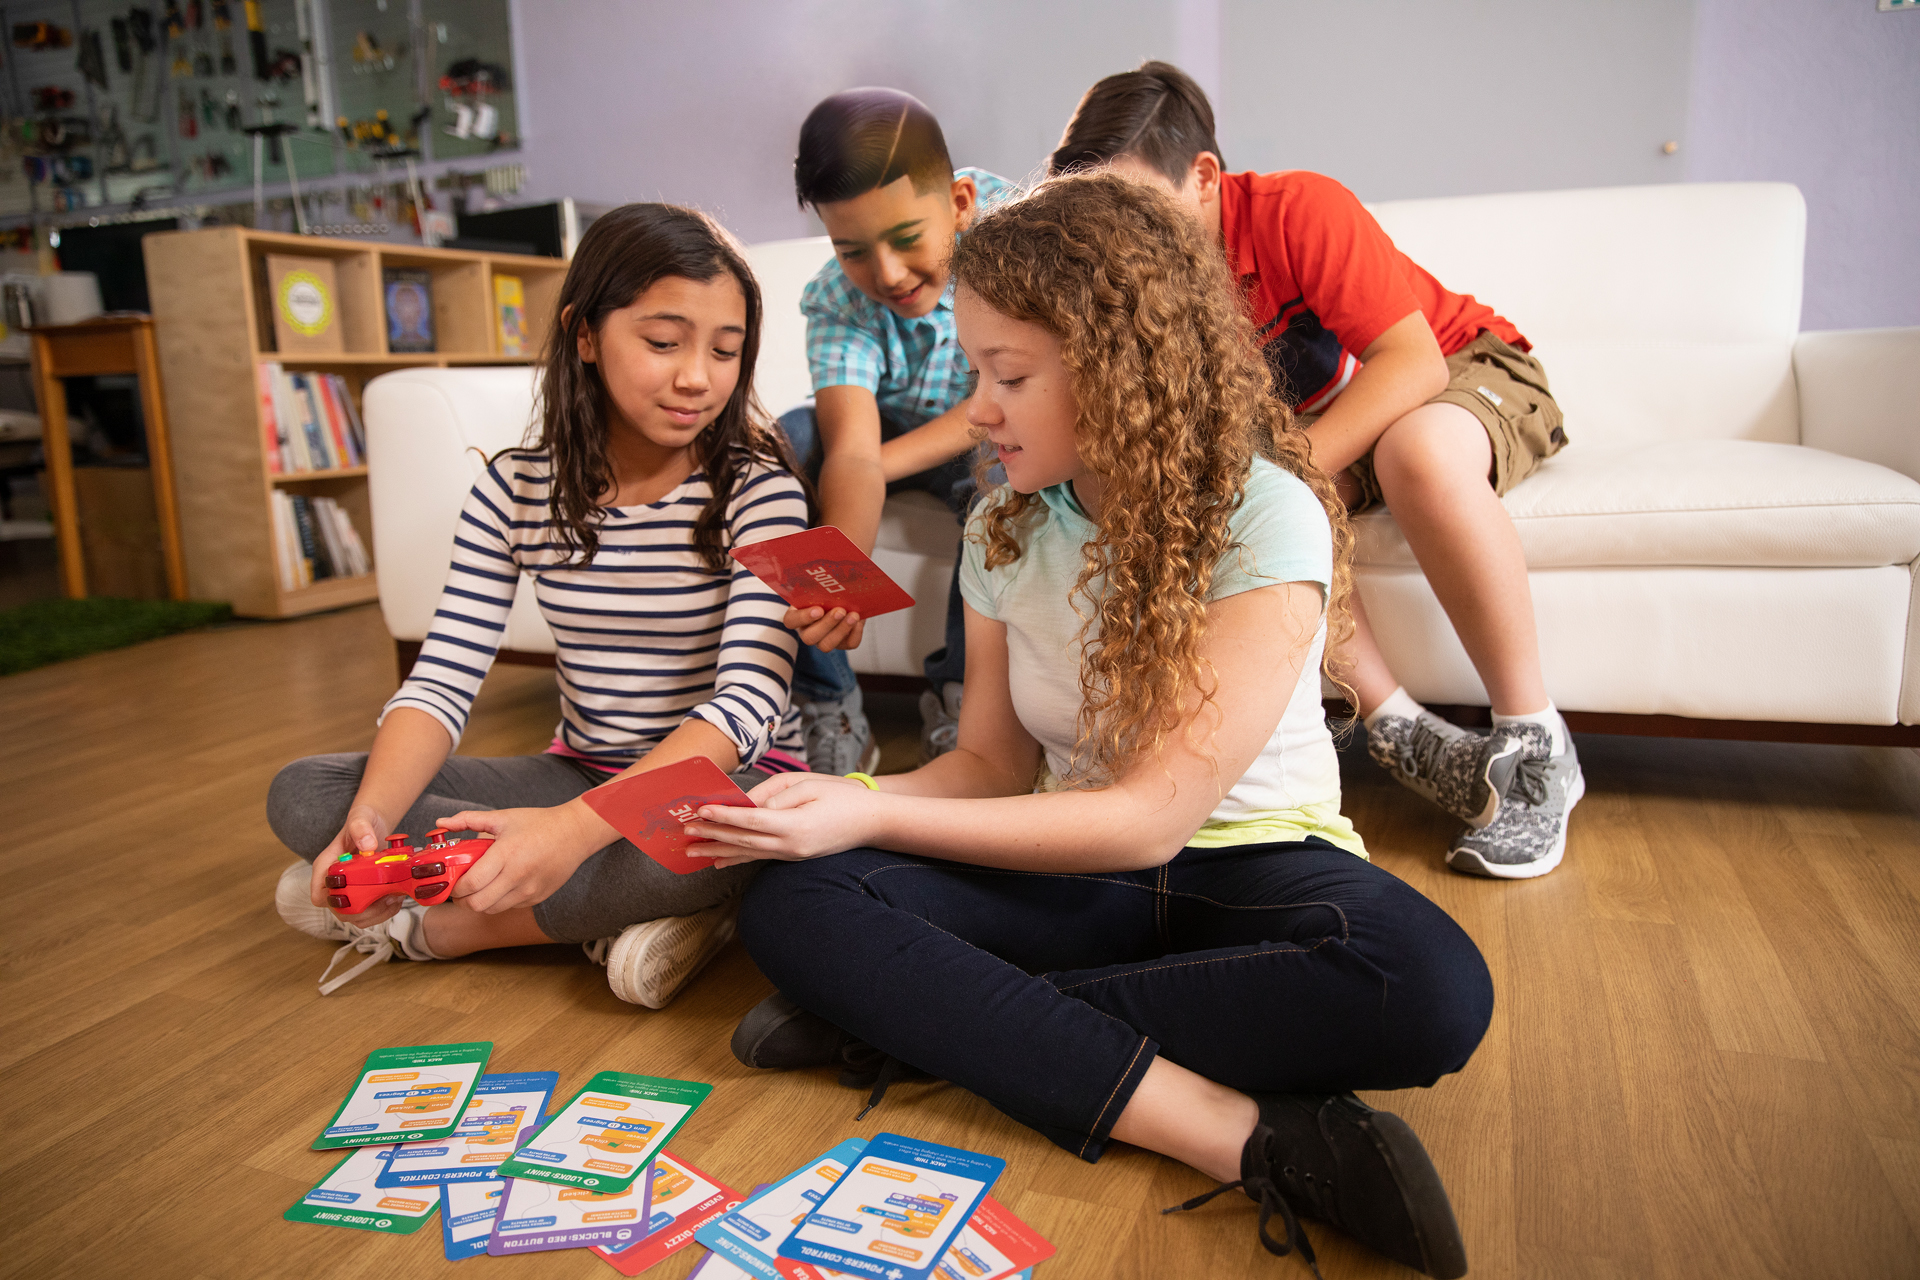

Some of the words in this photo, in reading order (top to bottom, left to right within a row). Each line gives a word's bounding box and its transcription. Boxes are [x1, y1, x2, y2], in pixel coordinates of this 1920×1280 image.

[806, 566, 846, 594] CODE
[399, 1174, 441, 1182] CONTROL
[442, 1171, 482, 1179] POWERS:
[524, 1169, 551, 1177] SHINY
[551, 1173, 583, 1182] LOOKS:
[657, 1172, 679, 1185] forever
[672, 1178, 688, 1188] when
[698, 1195, 724, 1211] EVENT!
[313, 1212, 342, 1221] SHINY
[342, 1215, 375, 1224] LOOKS:
[692, 1212, 723, 1231] MAGIC:
[547, 1235, 567, 1243] RED
[569, 1231, 612, 1241] BLOCKS:
[665, 1230, 693, 1249] DIZZY
[504, 1238, 543, 1248] BUTTON
[802, 1247, 842, 1262] CONTROL
[843, 1258, 884, 1274] POWERS:
[792, 1266, 810, 1280] EAR
